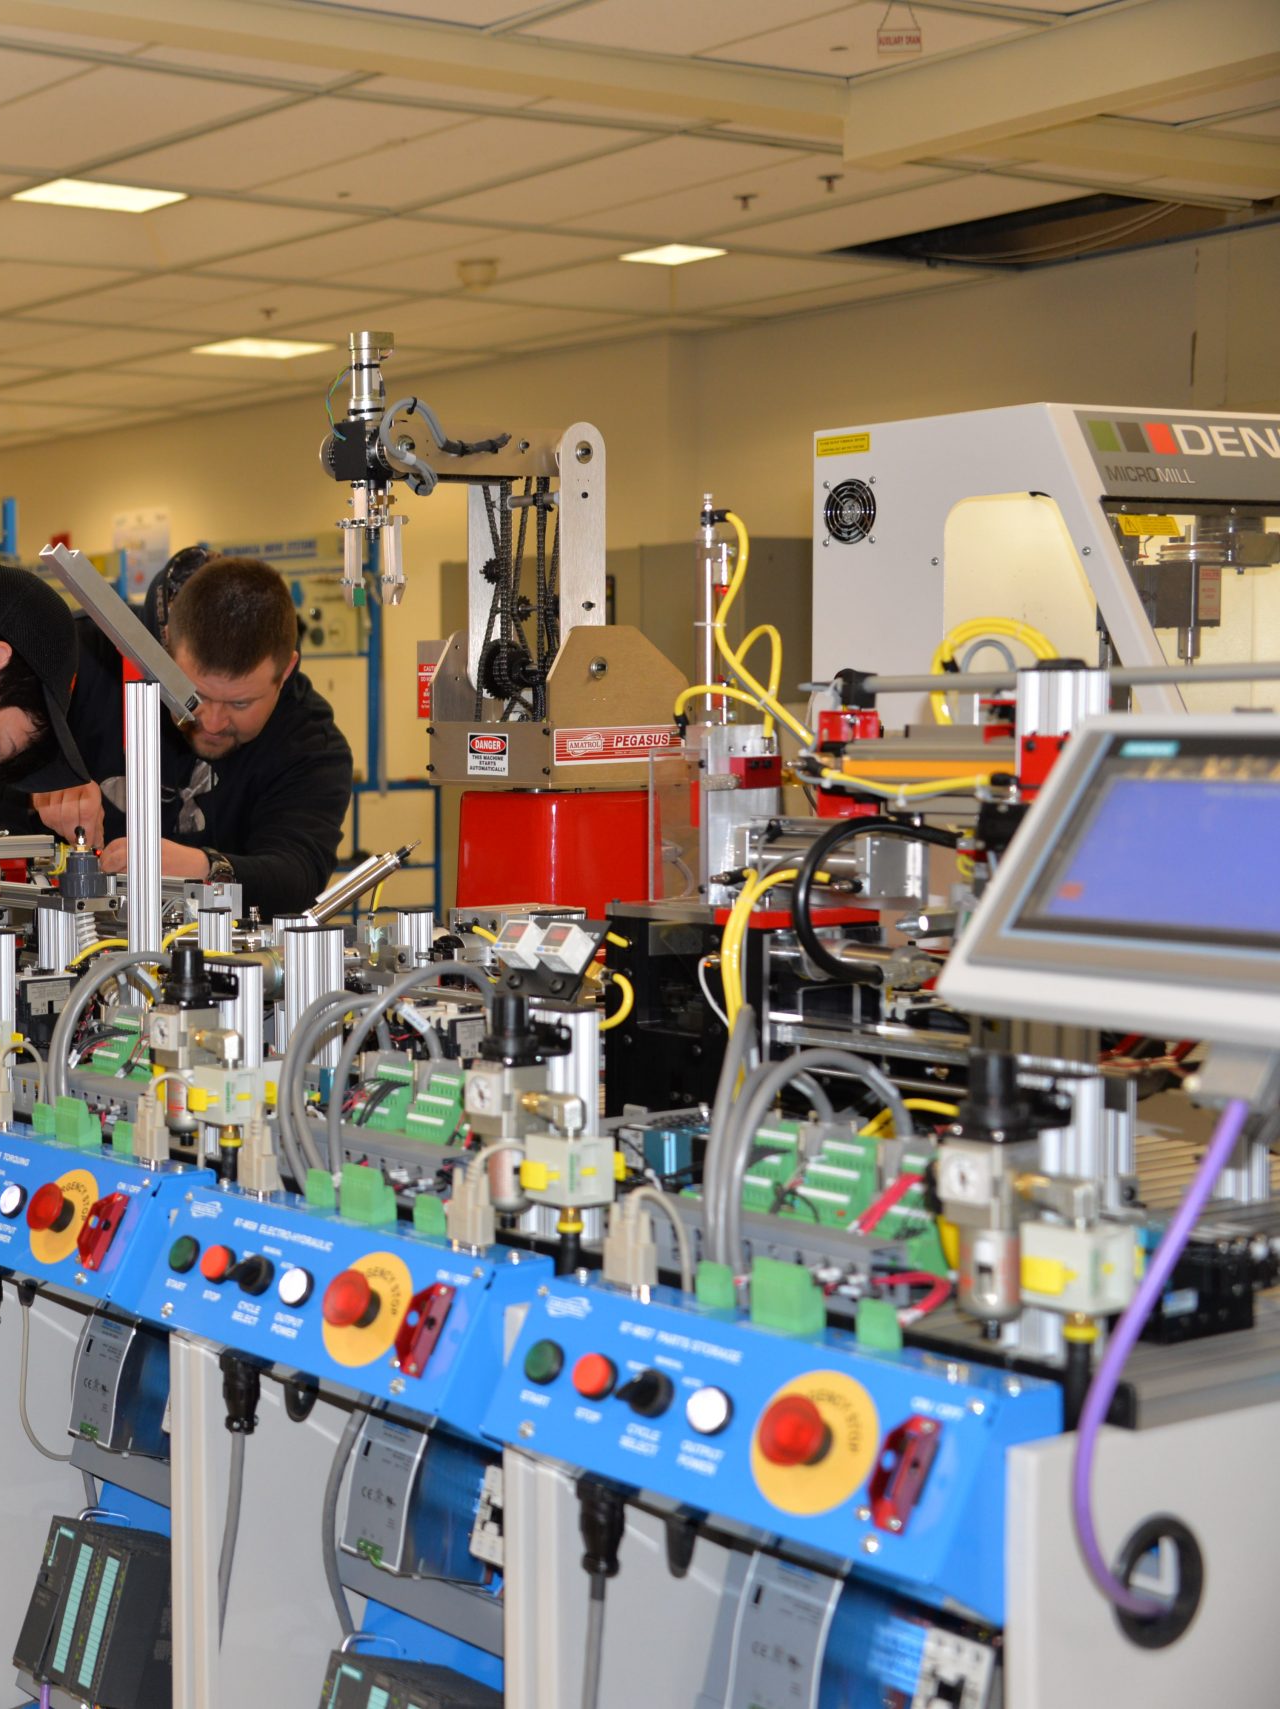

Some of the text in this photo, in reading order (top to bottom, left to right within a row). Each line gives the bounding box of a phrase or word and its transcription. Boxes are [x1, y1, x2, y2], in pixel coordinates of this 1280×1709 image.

[1171, 423, 1280, 458] DEN
[1105, 465, 1197, 484] MICROMILL
[475, 739, 501, 750] DANGER
[569, 740, 601, 749] AMATROL
[614, 734, 670, 747] PEGASUS
[165, 1277, 187, 1292] START
[202, 1289, 221, 1302] STOP
[237, 1300, 262, 1316] CYCLE
[231, 1310, 259, 1326] SELECT
[273, 1311, 304, 1329] OUTPUT
[270, 1322, 299, 1339] POWER
[520, 1389, 552, 1408] START
[574, 1406, 602, 1424] STOP
[626, 1422, 662, 1442] CYCLE
[619, 1435, 660, 1458] SELECT
[679, 1439, 725, 1461] OUTPUT
[675, 1452, 718, 1477] POWER
